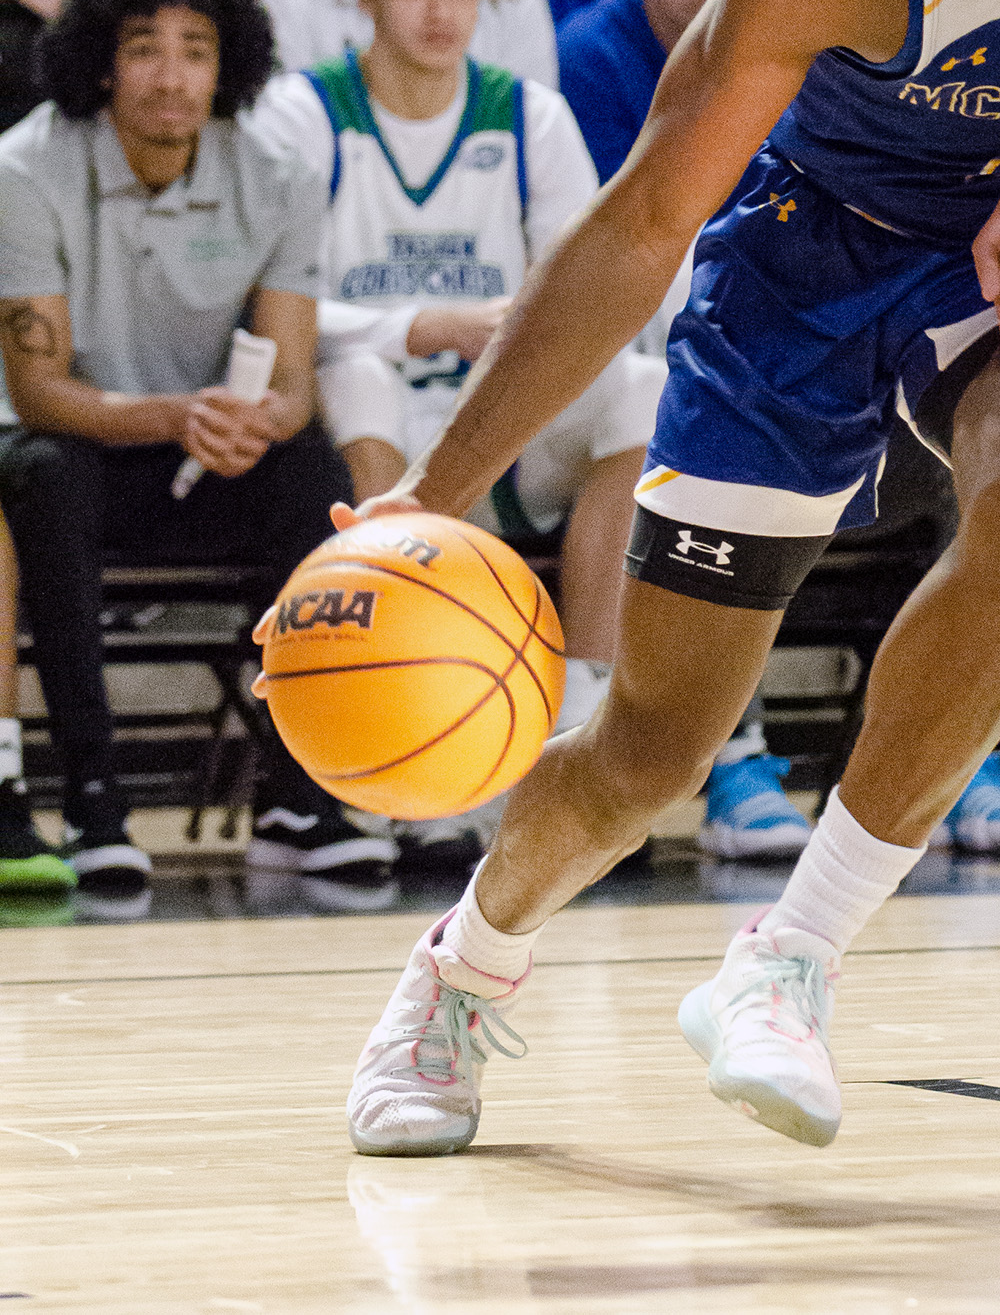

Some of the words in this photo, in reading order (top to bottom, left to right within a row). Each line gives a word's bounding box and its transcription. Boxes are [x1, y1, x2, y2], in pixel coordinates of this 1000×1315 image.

[667, 552, 695, 565] UNDER
[696, 563, 735, 576] ARMOUR
[273, 589, 375, 634] NCAA
